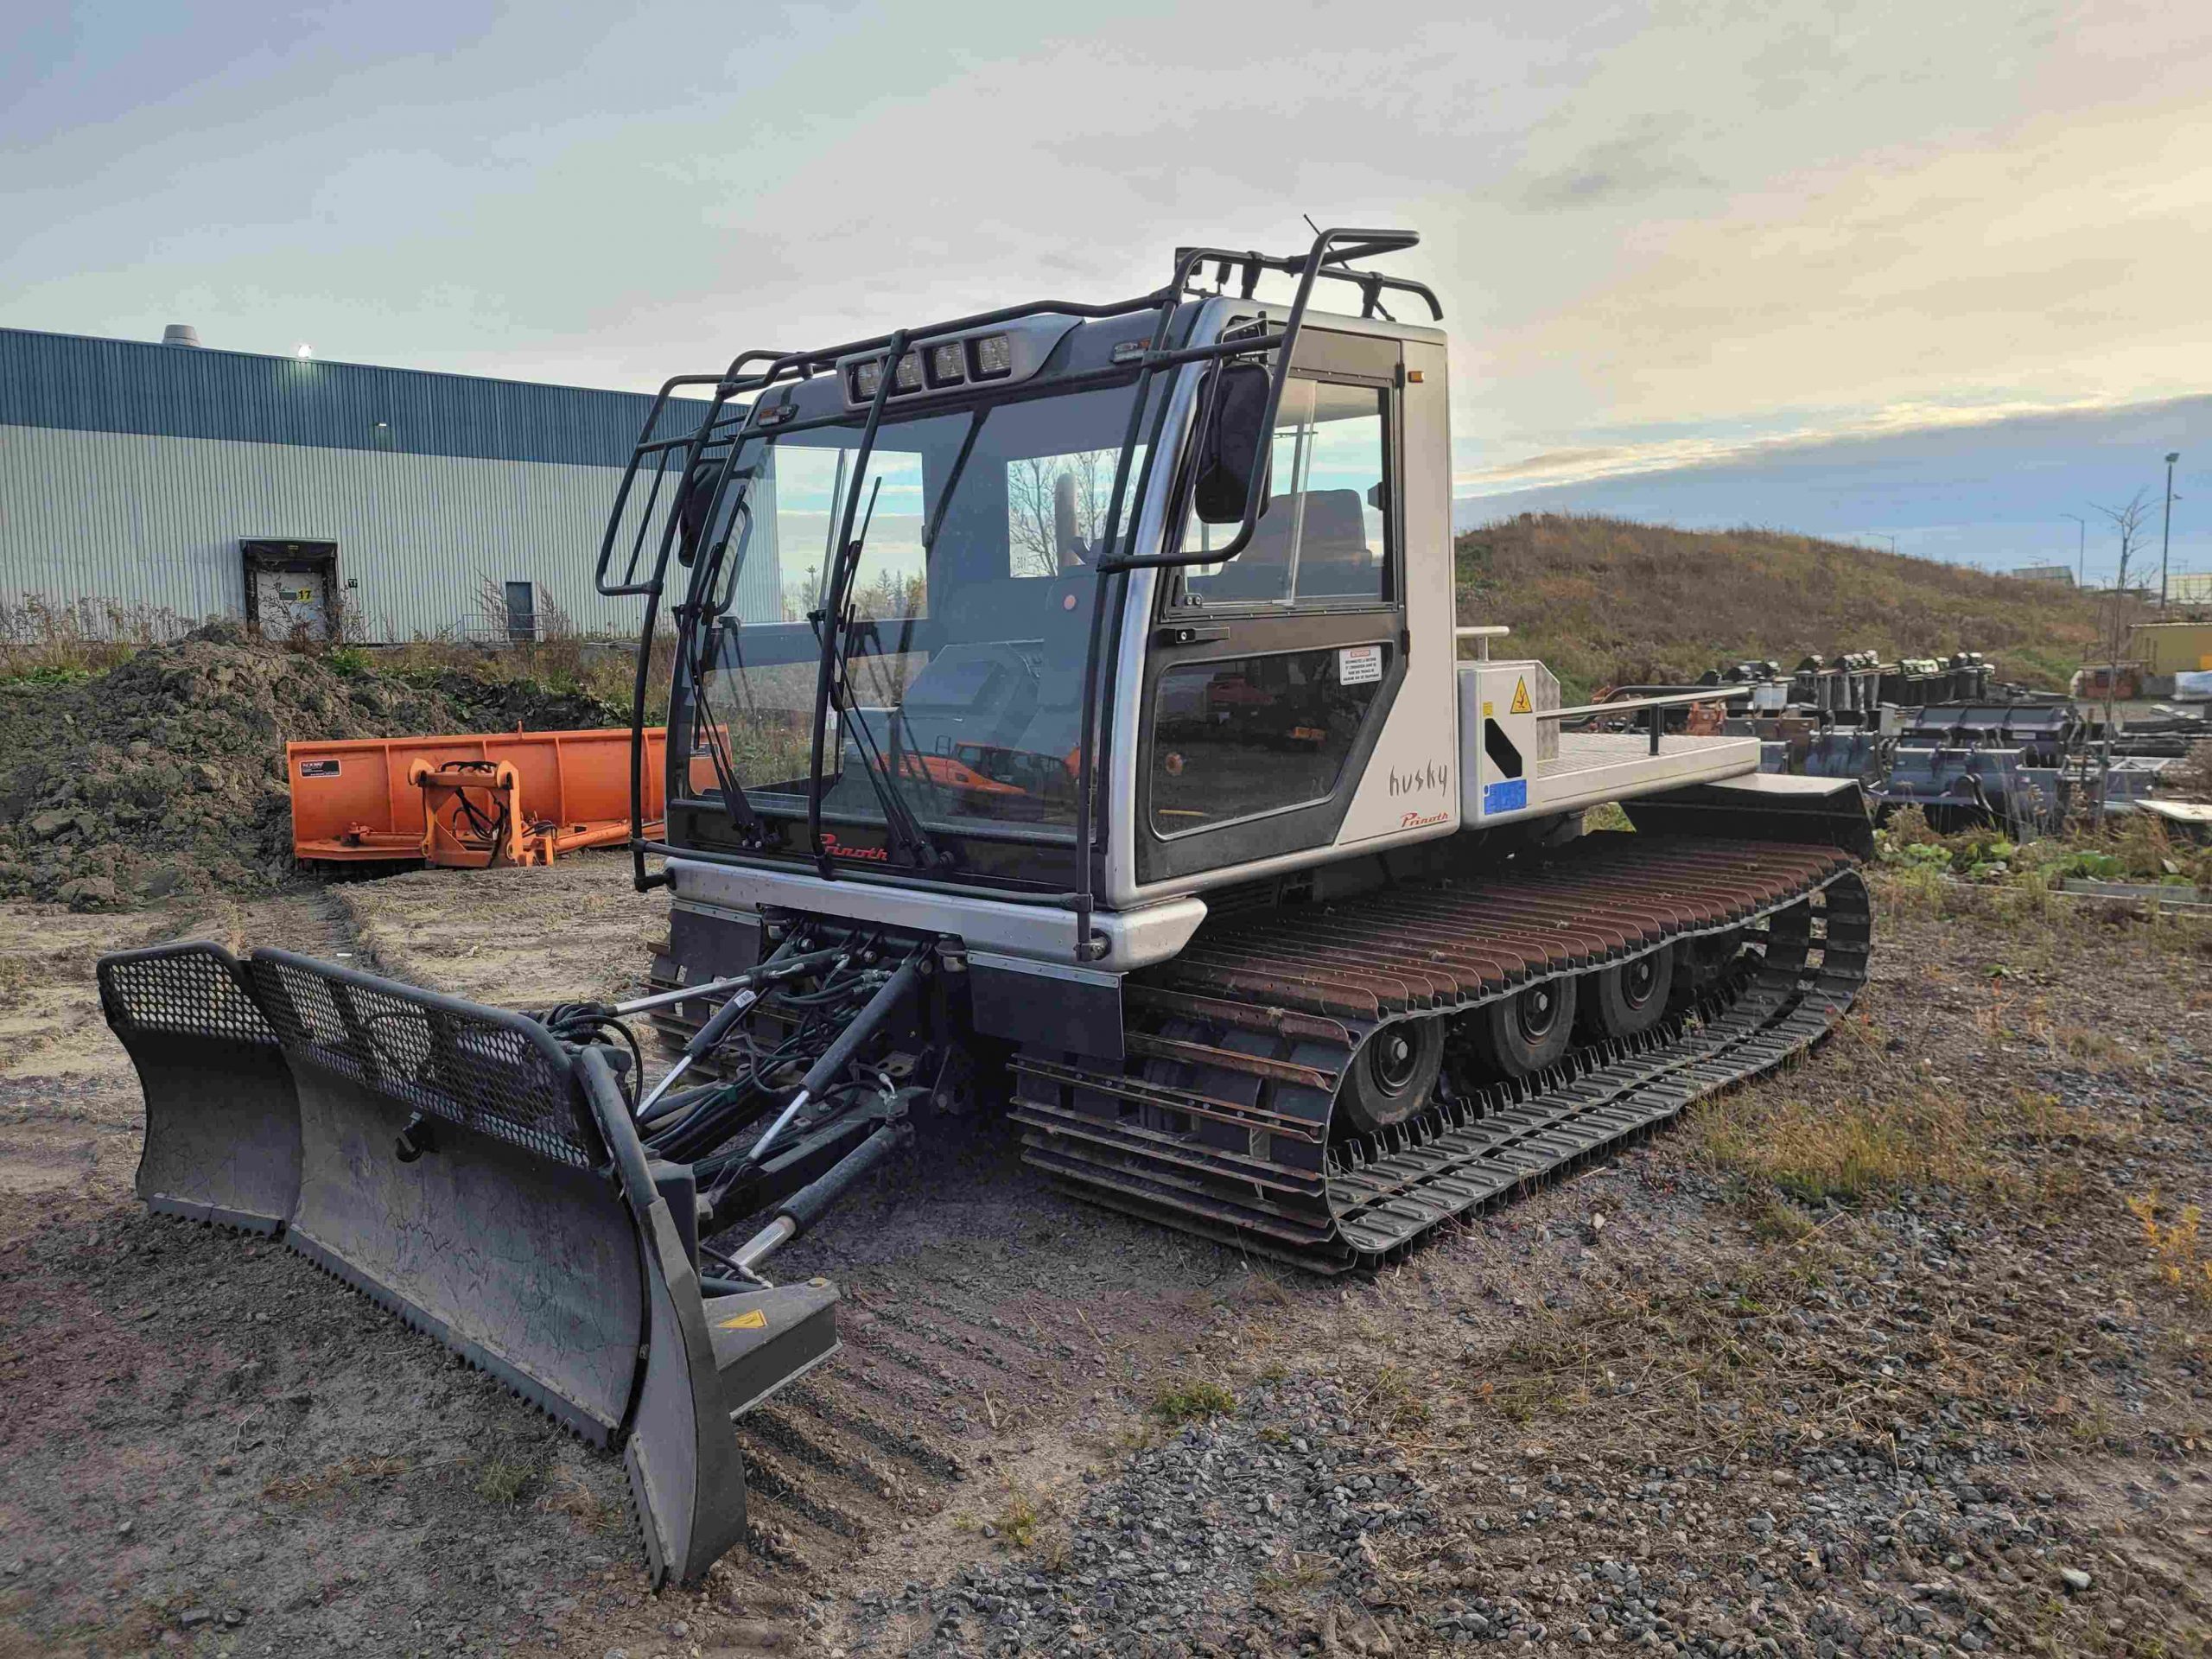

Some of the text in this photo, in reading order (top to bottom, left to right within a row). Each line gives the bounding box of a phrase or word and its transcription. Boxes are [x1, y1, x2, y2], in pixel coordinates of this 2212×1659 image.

[298, 589, 311, 600] 17
[1389, 759, 1448, 798] husky
[1401, 811, 1449, 828] Prinoth
